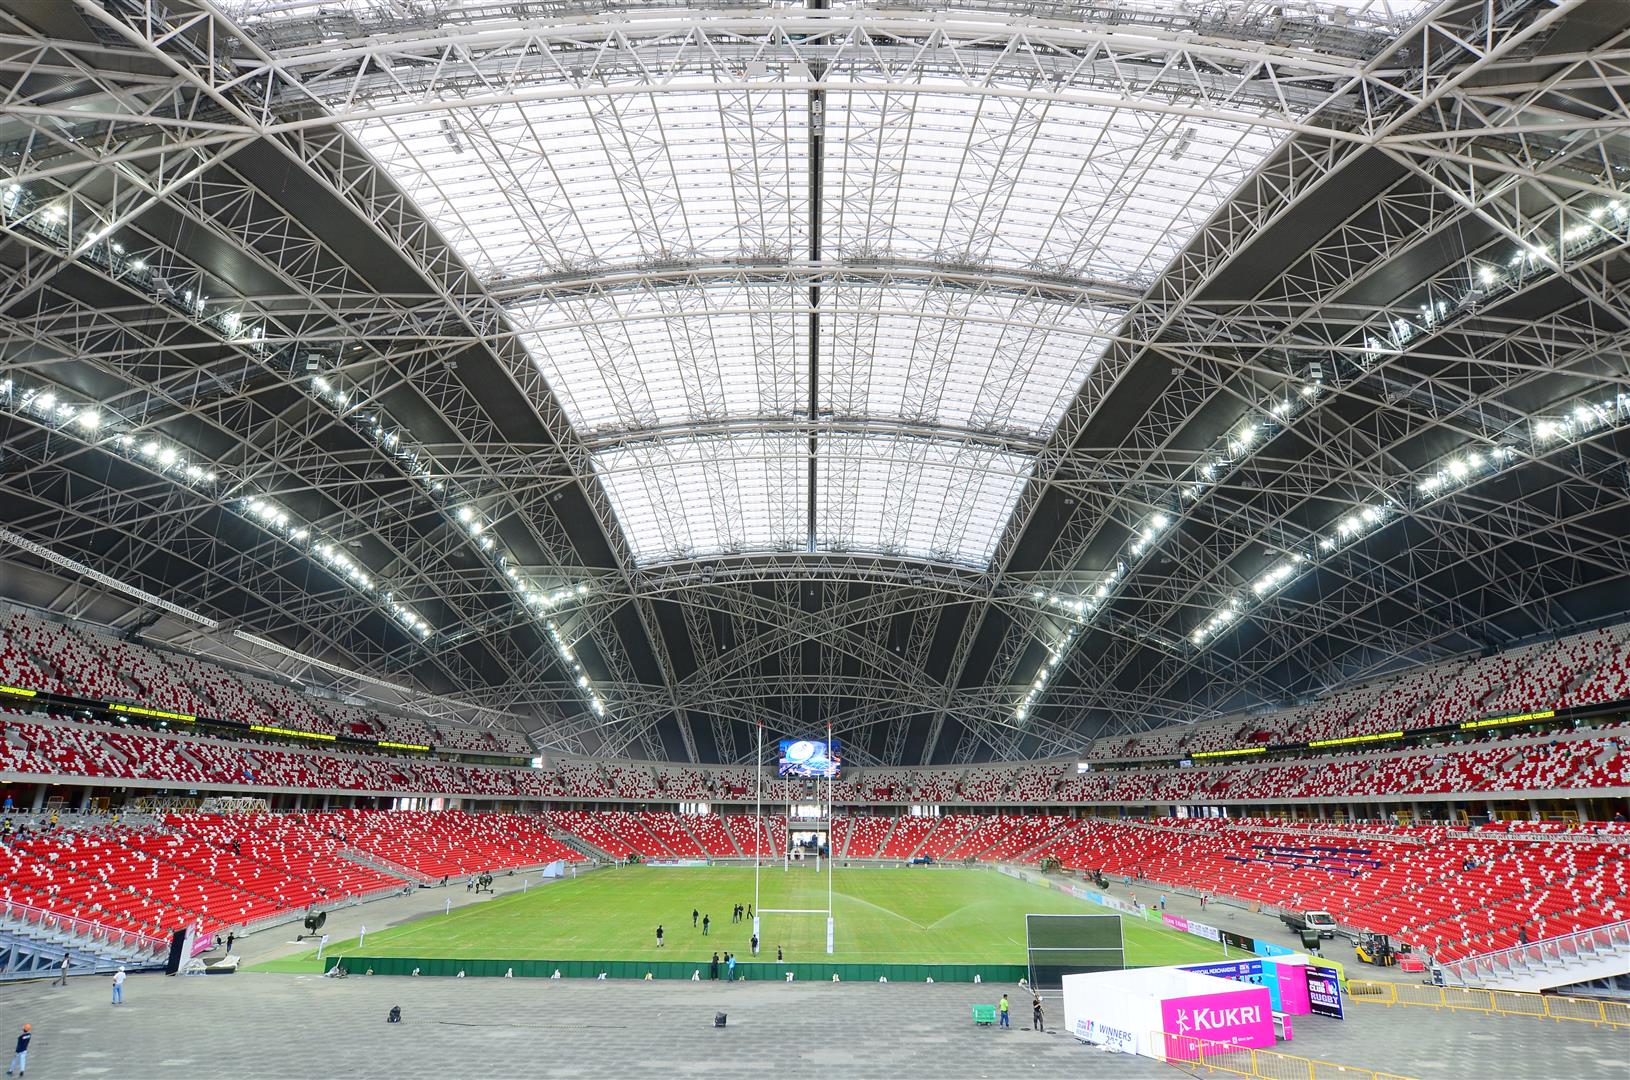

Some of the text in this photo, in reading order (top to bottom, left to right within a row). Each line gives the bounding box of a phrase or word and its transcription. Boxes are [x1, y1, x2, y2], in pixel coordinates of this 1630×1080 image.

[1309, 985, 1326, 994] CLUB
[1310, 993, 1339, 1005] RUGBY
[1192, 1005, 1261, 1031] KUKRI
[1099, 1023, 1132, 1042] WINNERS
